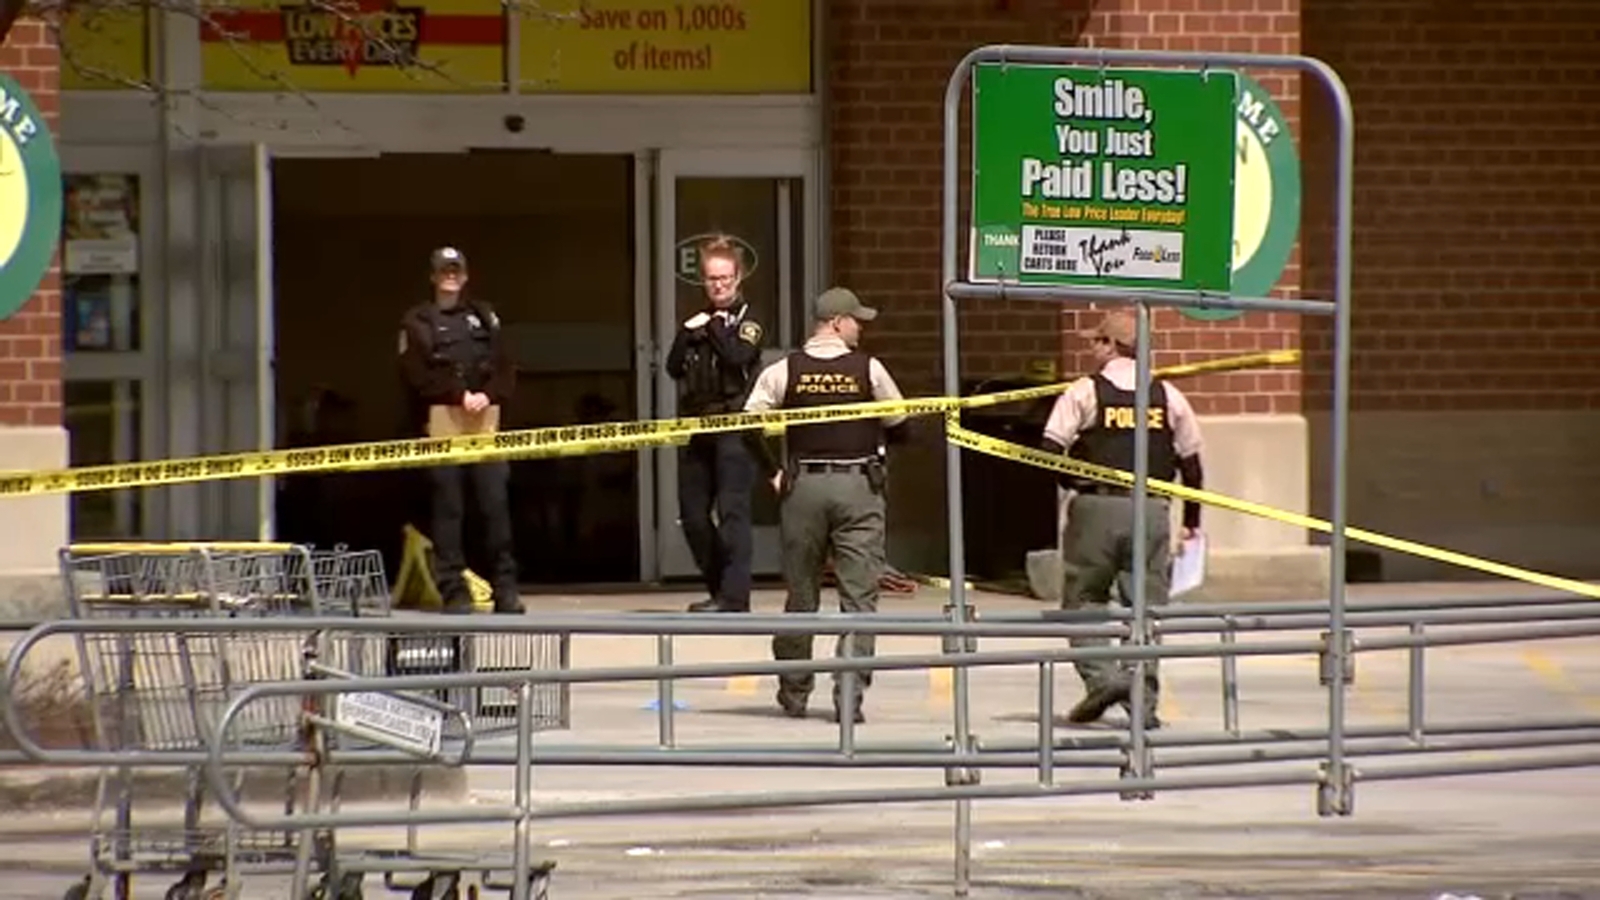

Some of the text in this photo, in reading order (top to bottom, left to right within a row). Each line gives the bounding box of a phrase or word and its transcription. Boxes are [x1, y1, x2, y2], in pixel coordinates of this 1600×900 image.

[579, 4, 747, 34] Save on 1,000s
[614, 41, 712, 70] of items!
[1054, 77, 1153, 124] Smile,
[1054, 124, 1153, 157] You Just
[1021, 157, 1187, 203] Paid Less!
[1022, 202, 1039, 218] The
[1084, 206, 1108, 220] Price
[1033, 228, 1067, 242] PLEASE
[1031, 244, 1068, 256] RETURN
[1024, 256, 1078, 271] CARTS HERE
[795, 383, 861, 394] POLICE
[800, 373, 856, 384] STATE
[1104, 406, 1164, 429] POLCE
